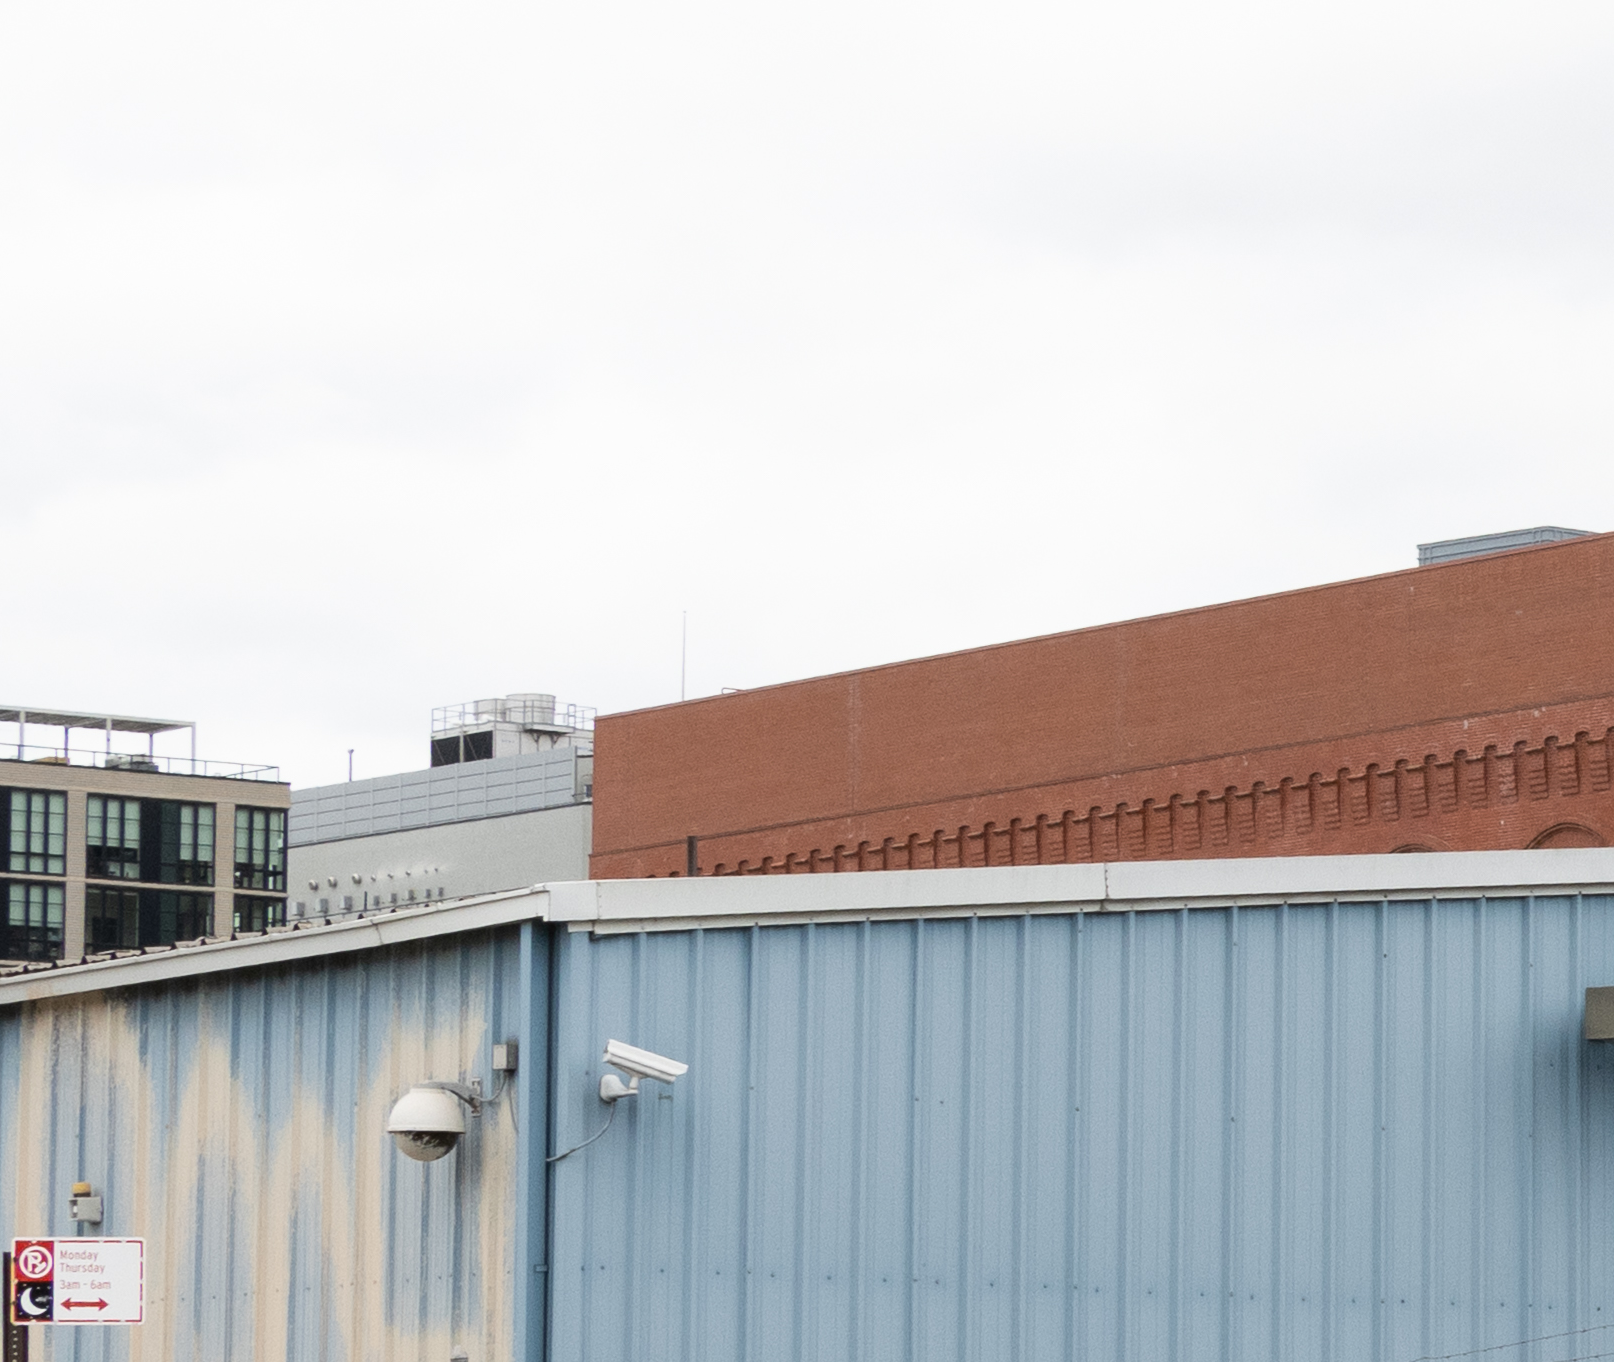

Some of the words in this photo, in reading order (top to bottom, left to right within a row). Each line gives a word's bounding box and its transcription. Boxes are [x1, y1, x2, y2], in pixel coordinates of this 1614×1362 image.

[59, 1250, 98, 1262] Monday
[59, 1262, 105, 1275] Thursday
[59, 1279, 80, 1290] 3am
[90, 1279, 111, 1290] 6am
